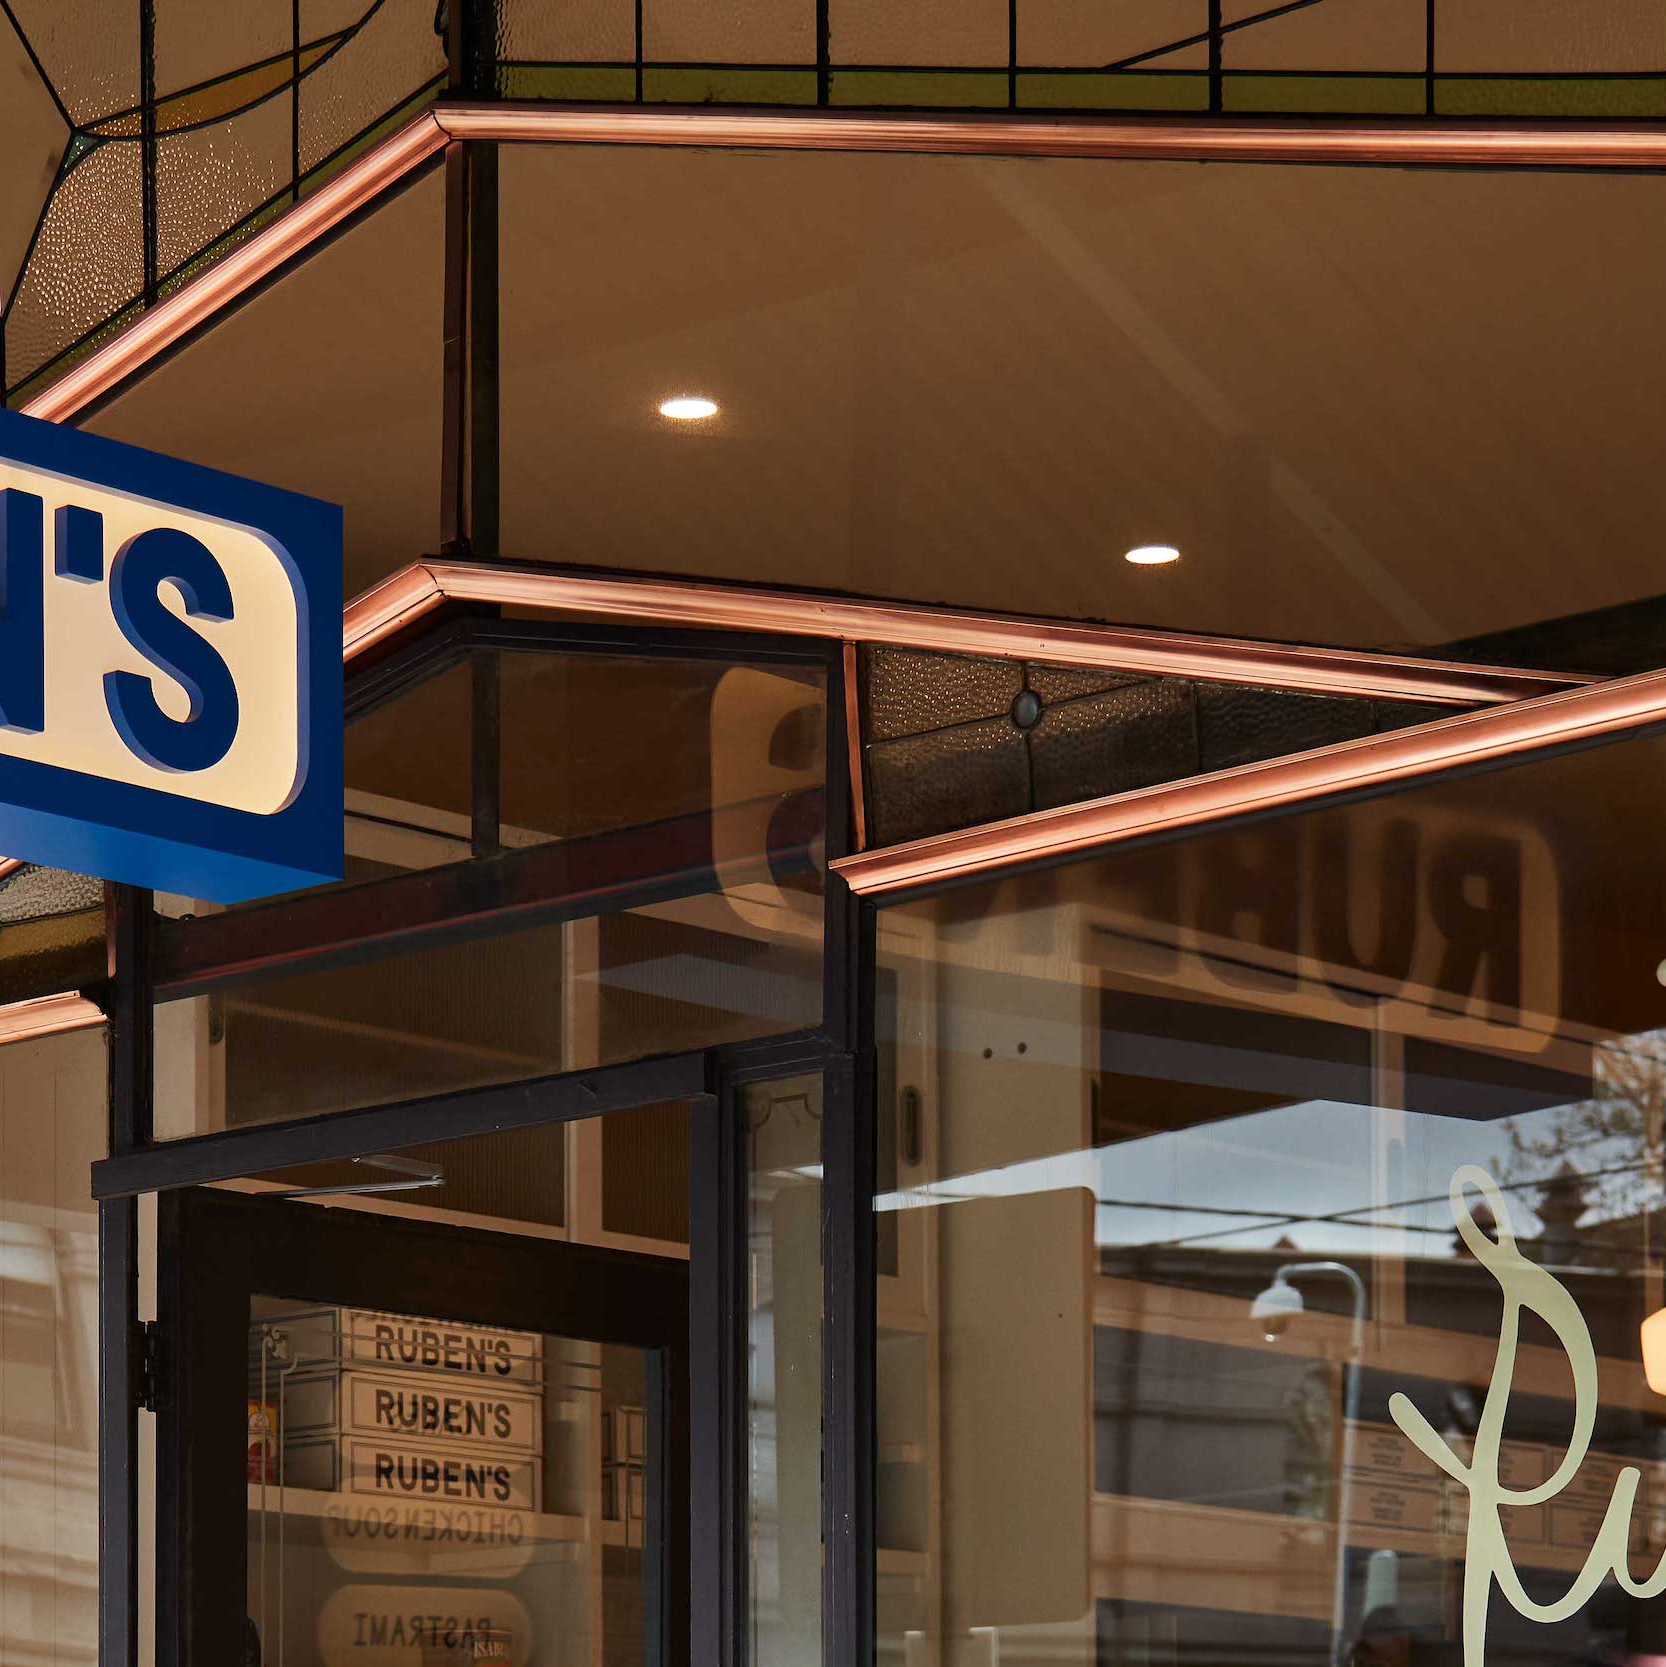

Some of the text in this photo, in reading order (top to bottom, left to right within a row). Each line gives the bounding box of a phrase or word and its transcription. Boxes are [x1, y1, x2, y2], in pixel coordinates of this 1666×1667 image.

[374, 1323, 513, 1377] RUBEN'S
[374, 1388, 513, 1440] RUBEN'S
[374, 1452, 513, 1502] RUBEN'S
